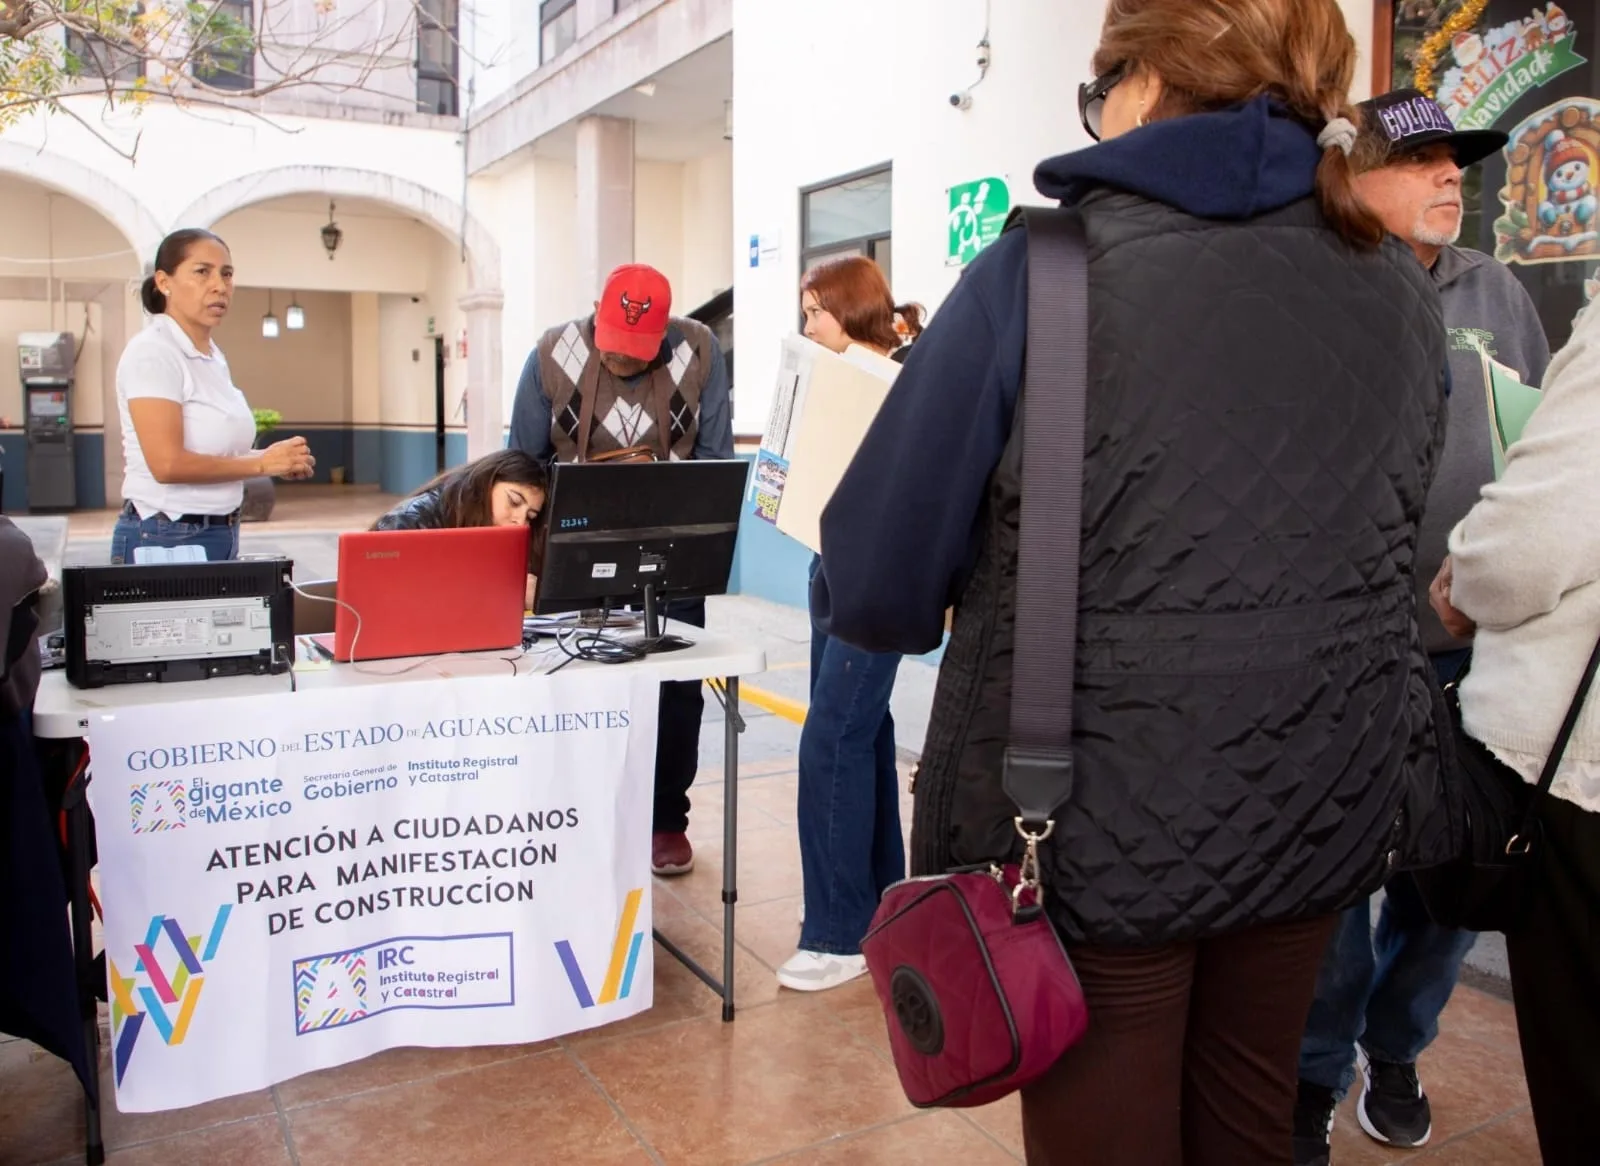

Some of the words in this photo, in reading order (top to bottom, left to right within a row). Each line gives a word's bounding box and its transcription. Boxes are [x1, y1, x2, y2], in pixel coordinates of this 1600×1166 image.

[1451, 36, 1523, 108] FELIZ
[127, 737, 276, 771] GOBIERNO
[281, 742, 302, 753] DEL
[304, 723, 404, 753] ESTADO
[406, 728, 421, 737] DE
[421, 709, 630, 740] AGUASCALIENTES
[352, 765, 385, 778] General
[387, 763, 398, 772] de
[408, 757, 461, 771] Instituto
[463, 755, 518, 769] Registral
[192, 777, 203, 788] El
[304, 776, 398, 801] Gobierno
[409, 774, 417, 786] y
[419, 770, 479, 783] Catastral
[188, 778, 283, 807] gigante
[189, 808, 206, 819] de
[206, 800, 292, 824] México
[206, 825, 357, 872] ATENCIÓN
[367, 824, 384, 846] A
[393, 807, 579, 840] CIUDADANOS
[237, 872, 317, 904] PARA
[336, 839, 557, 887] MANIFESTACIÓN
[268, 907, 304, 936] DE
[314, 876, 534, 924] CONSTRUCCÍON
[377, 946, 415, 970] IRC
[380, 970, 435, 986] Instituto
[437, 968, 499, 984] Registral
[381, 990, 389, 1003] y
[393, 986, 457, 998] Catastral
